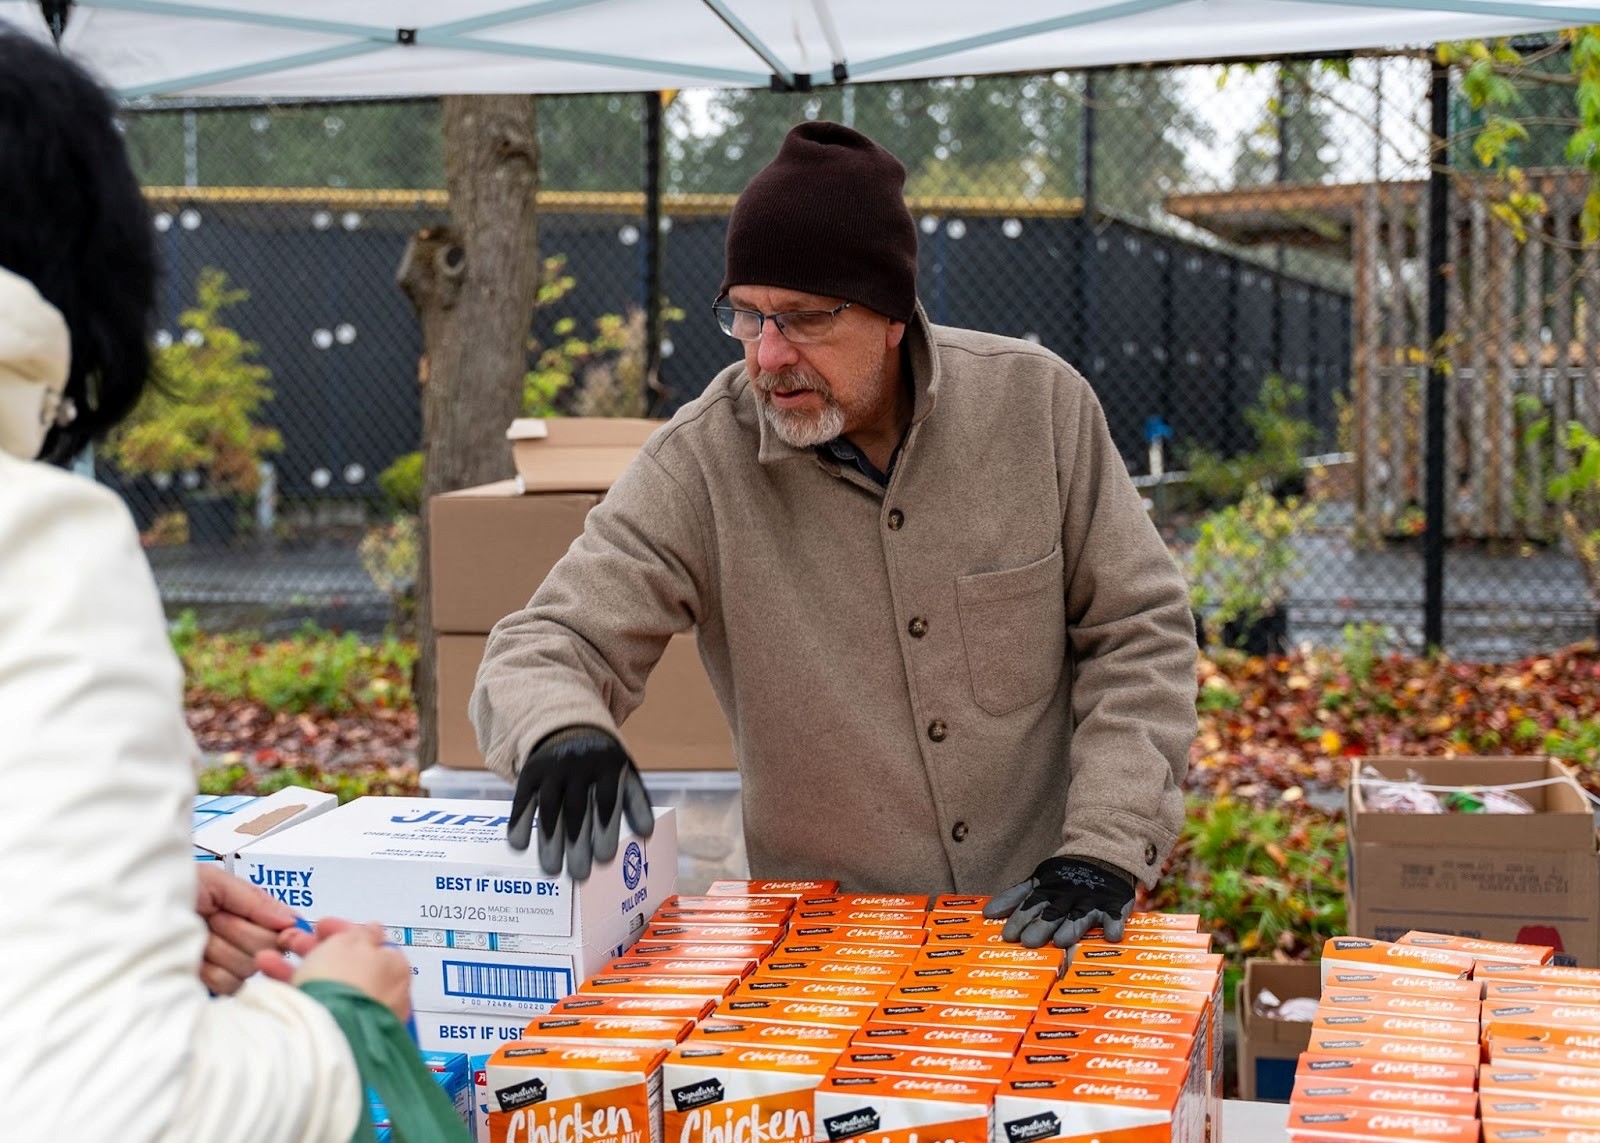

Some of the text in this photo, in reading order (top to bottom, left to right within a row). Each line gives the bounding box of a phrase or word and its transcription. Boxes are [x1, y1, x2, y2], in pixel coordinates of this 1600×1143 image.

[435, 876, 559, 896] BEST IF USED BY:
[262, 888, 313, 907] IXES
[621, 886, 648, 915] PULL OPEN
[420, 904, 486, 921] 10/13/26
[515, 907, 554, 916] 10/13/2025
[846, 928, 903, 938] Chicken
[836, 947, 895, 956] Chicken
[978, 950, 1038, 960] Chicken
[820, 963, 882, 973] Chicken
[967, 969, 1029, 978] Chicken
[802, 983, 866, 993] Chicken
[954, 986, 1019, 996] Chicken
[518, 1002, 544, 1011] 00220
[783, 1003, 849, 1014] Chicken
[940, 1007, 1005, 1018] Chicken
[1104, 1009, 1171, 1020] Chicken
[439, 1025, 476, 1039] BEST
[481, 1027, 494, 1040] IF
[760, 1026, 829, 1037] Chicken
[923, 1030, 992, 1041] Chicken
[1094, 1033, 1163, 1044] Chicken
[737, 1051, 809, 1062] Chicken
[910, 1055, 982, 1067] Chicken
[1086, 1057, 1157, 1069] Chicken
[893, 1079, 967, 1090] Chicken
[1072, 1083, 1147, 1095] Chicken
[501, 1086, 539, 1104] Signature
[677, 1086, 715, 1103] Signature
[506, 1102, 633, 1143] Chicken
[680, 1104, 811, 1143] Chicken
[830, 1114, 871, 1134] Signature
[1010, 1119, 1052, 1138] Signature
